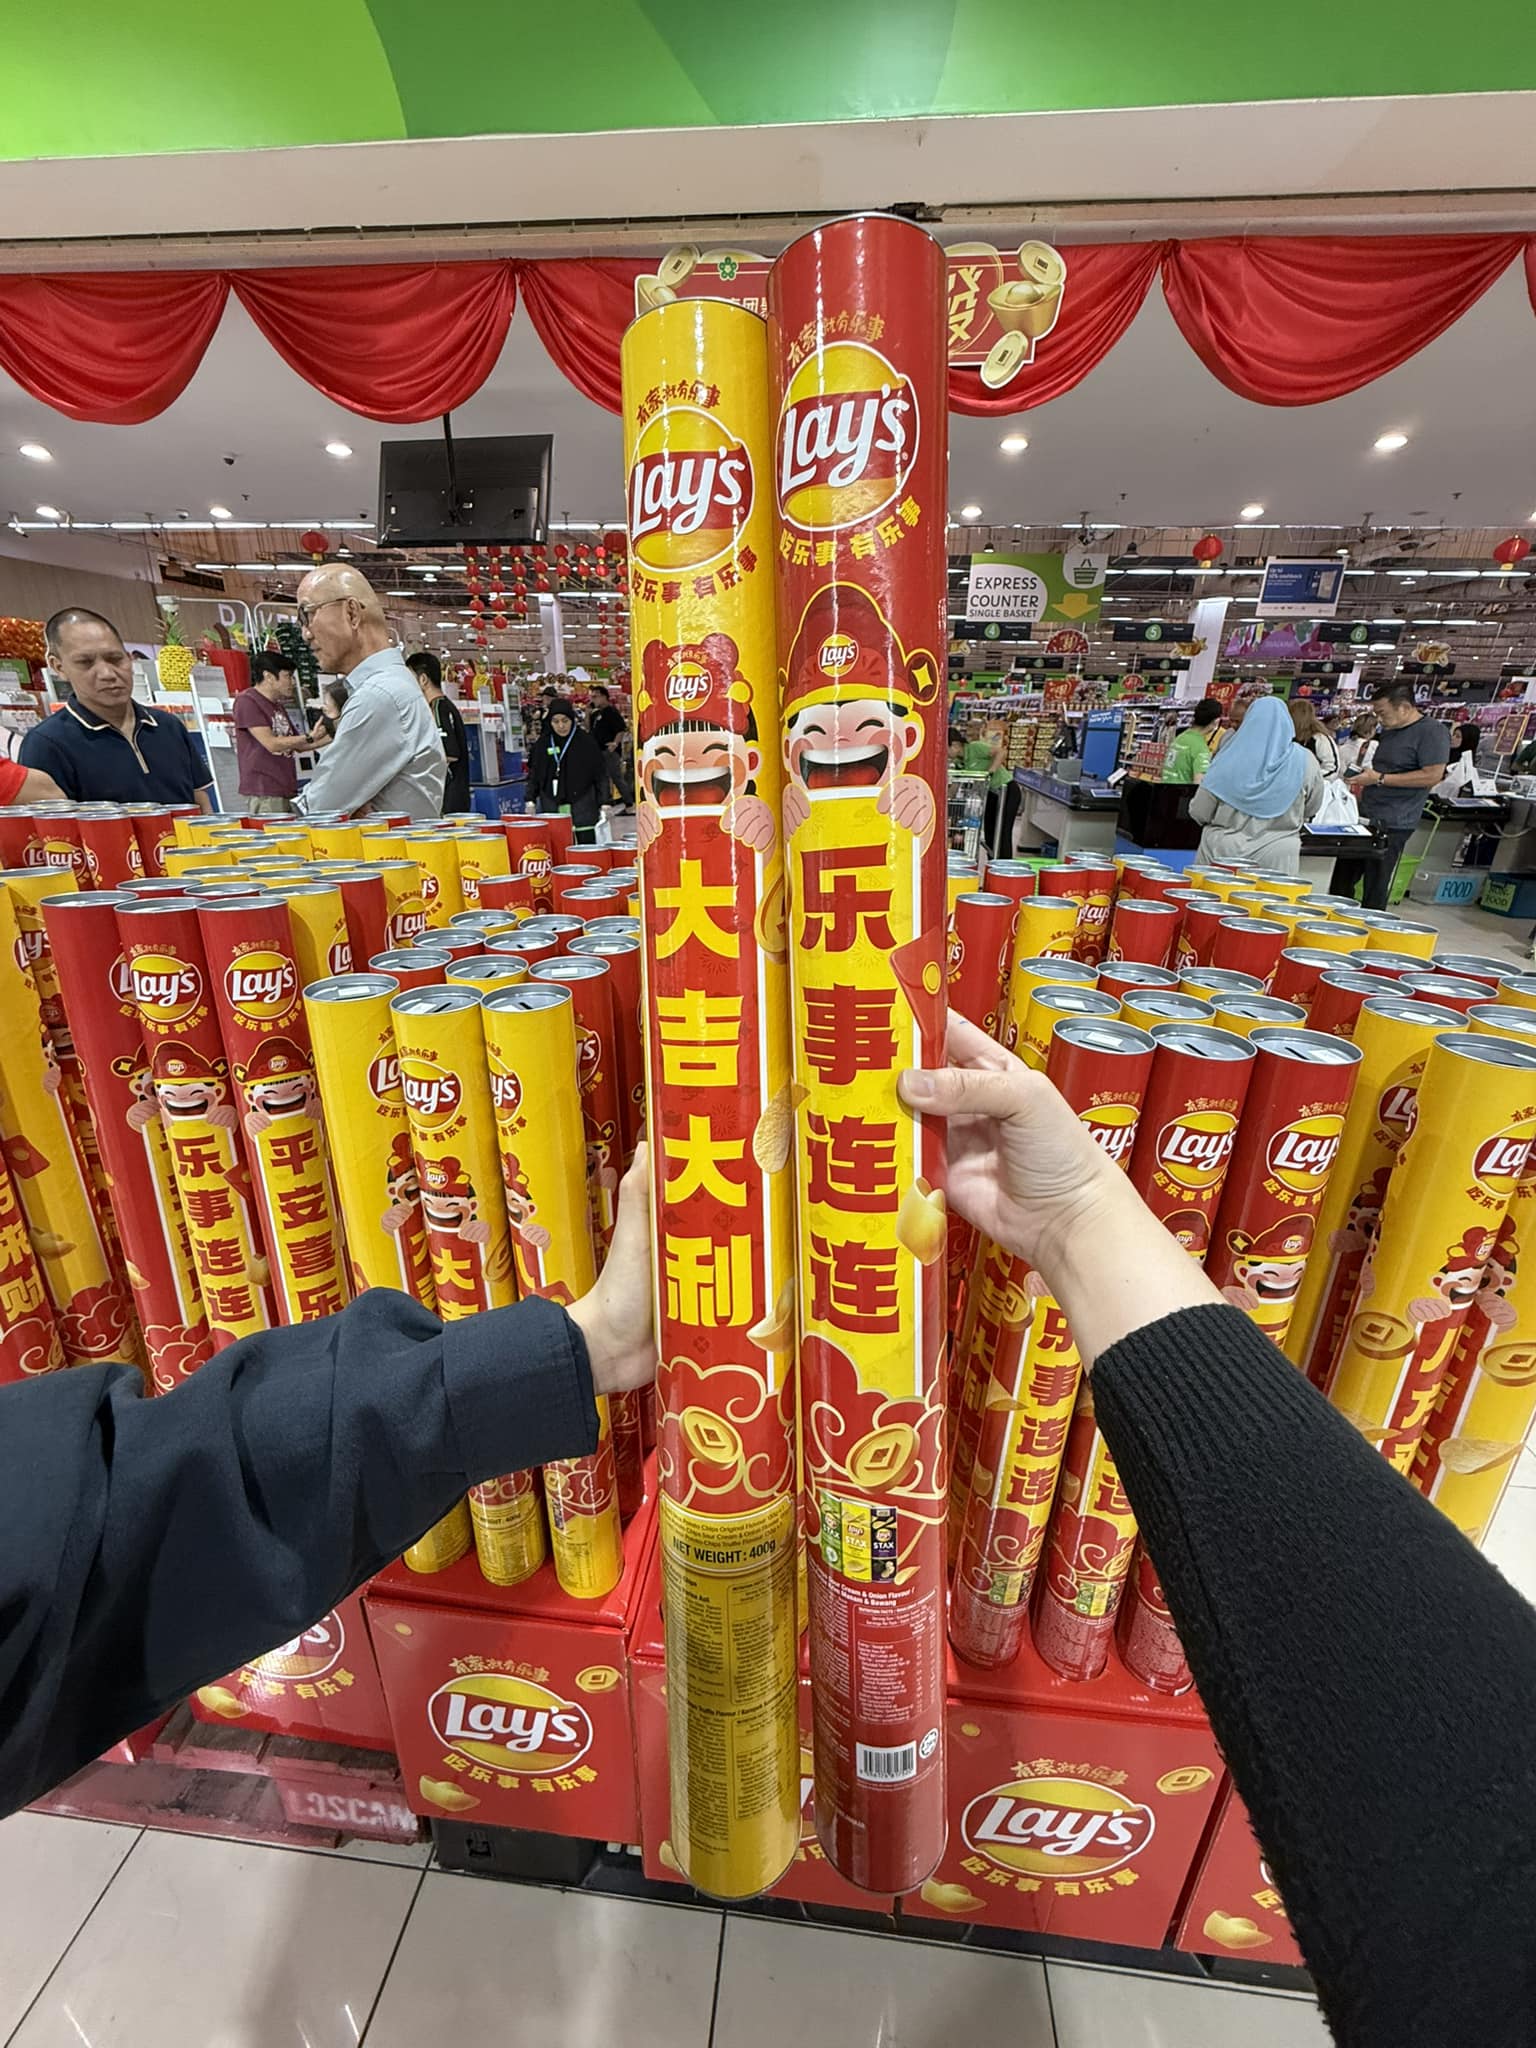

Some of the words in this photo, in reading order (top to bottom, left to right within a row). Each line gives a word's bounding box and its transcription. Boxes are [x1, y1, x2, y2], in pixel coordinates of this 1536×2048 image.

[780, 383, 911, 498] Lay's
[632, 446, 746, 541] Lay's
[850, 495, 922, 561] 有乐事
[975, 576, 1037, 590] EXPRESS
[969, 609, 1002, 618] SINGLE
[1003, 609, 1037, 618] BASKET
[970, 594, 1039, 608] COUNTER
[821, 643, 855, 668] Lay's
[668, 673, 709, 700] Lay's
[1441, 881, 1473, 897] FOOD
[395, 912, 426, 940] Lay
[134, 969, 196, 1008] Lay's
[232, 964, 294, 1004] Lay's
[653, 858, 753, 1328] 大吉大利
[800, 842, 901, 1334] 乐事连连
[1161, 1125, 1237, 1172] Lay's
[1153, 1171, 1197, 1202] 吃乐事
[1262, 1177, 1308, 1207] 吃乐事
[172, 1133, 256, 1323] 乐事连连
[268, 1127, 345, 1323] 平安喜乐
[673, 1536, 690, 1556] NET
[749, 1539, 776, 1559] 400g
[845, 1536, 867, 1549] STAX
[841, 1583, 861, 1597] Cream
[888, 1589, 911, 1599] Flavour
[294, 1667, 355, 1699] 有乐事
[449, 1654, 550, 1683] 有家就有乐事
[445, 1693, 580, 1753] Lay's
[443, 1753, 520, 1790] 吃乐事
[529, 1764, 598, 1792] 有乐事
[1010, 1757, 1129, 1786] 有家就有乐事
[973, 1796, 1143, 1856] Lay's
[960, 1855, 1043, 1892] 吃乐事
[1054, 1867, 1139, 1896] 有乐事
